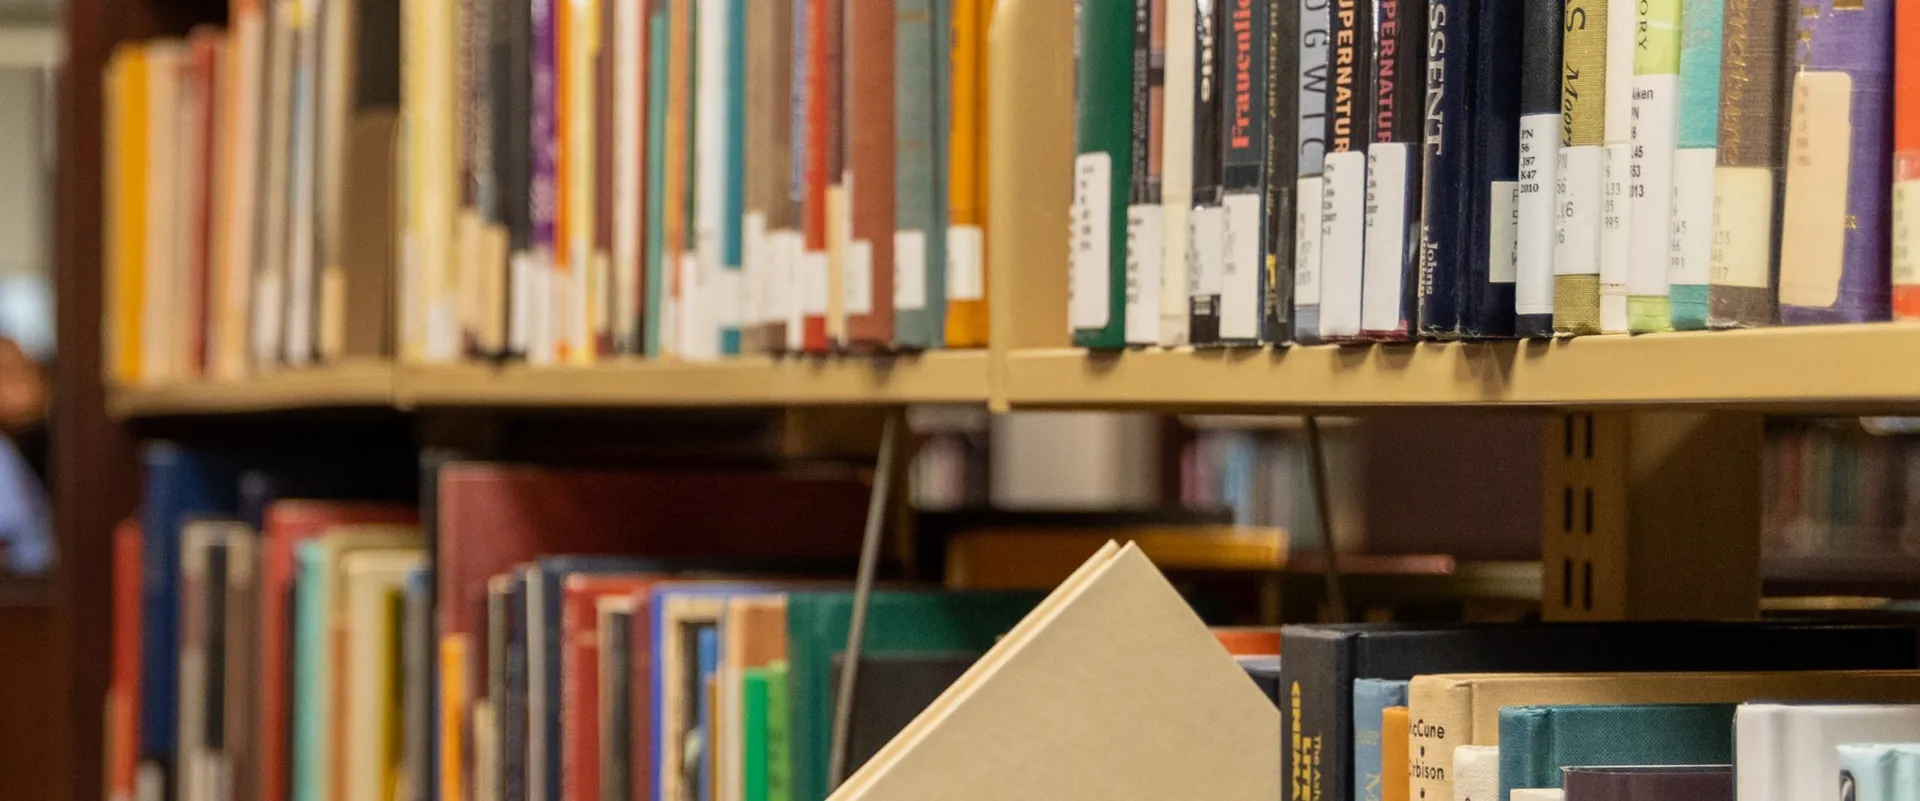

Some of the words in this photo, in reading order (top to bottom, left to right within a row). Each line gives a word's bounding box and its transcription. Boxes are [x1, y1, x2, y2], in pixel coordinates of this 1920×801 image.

[1521, 128, 1534, 139] PN
[1520, 142, 1530, 153] 56
[1520, 170, 1536, 181] K47
[1519, 183, 1539, 194] 2010
[1426, 241, 1438, 295] Johns
[1408, 718, 1445, 739] cCune
[1408, 758, 1444, 780] rbison
